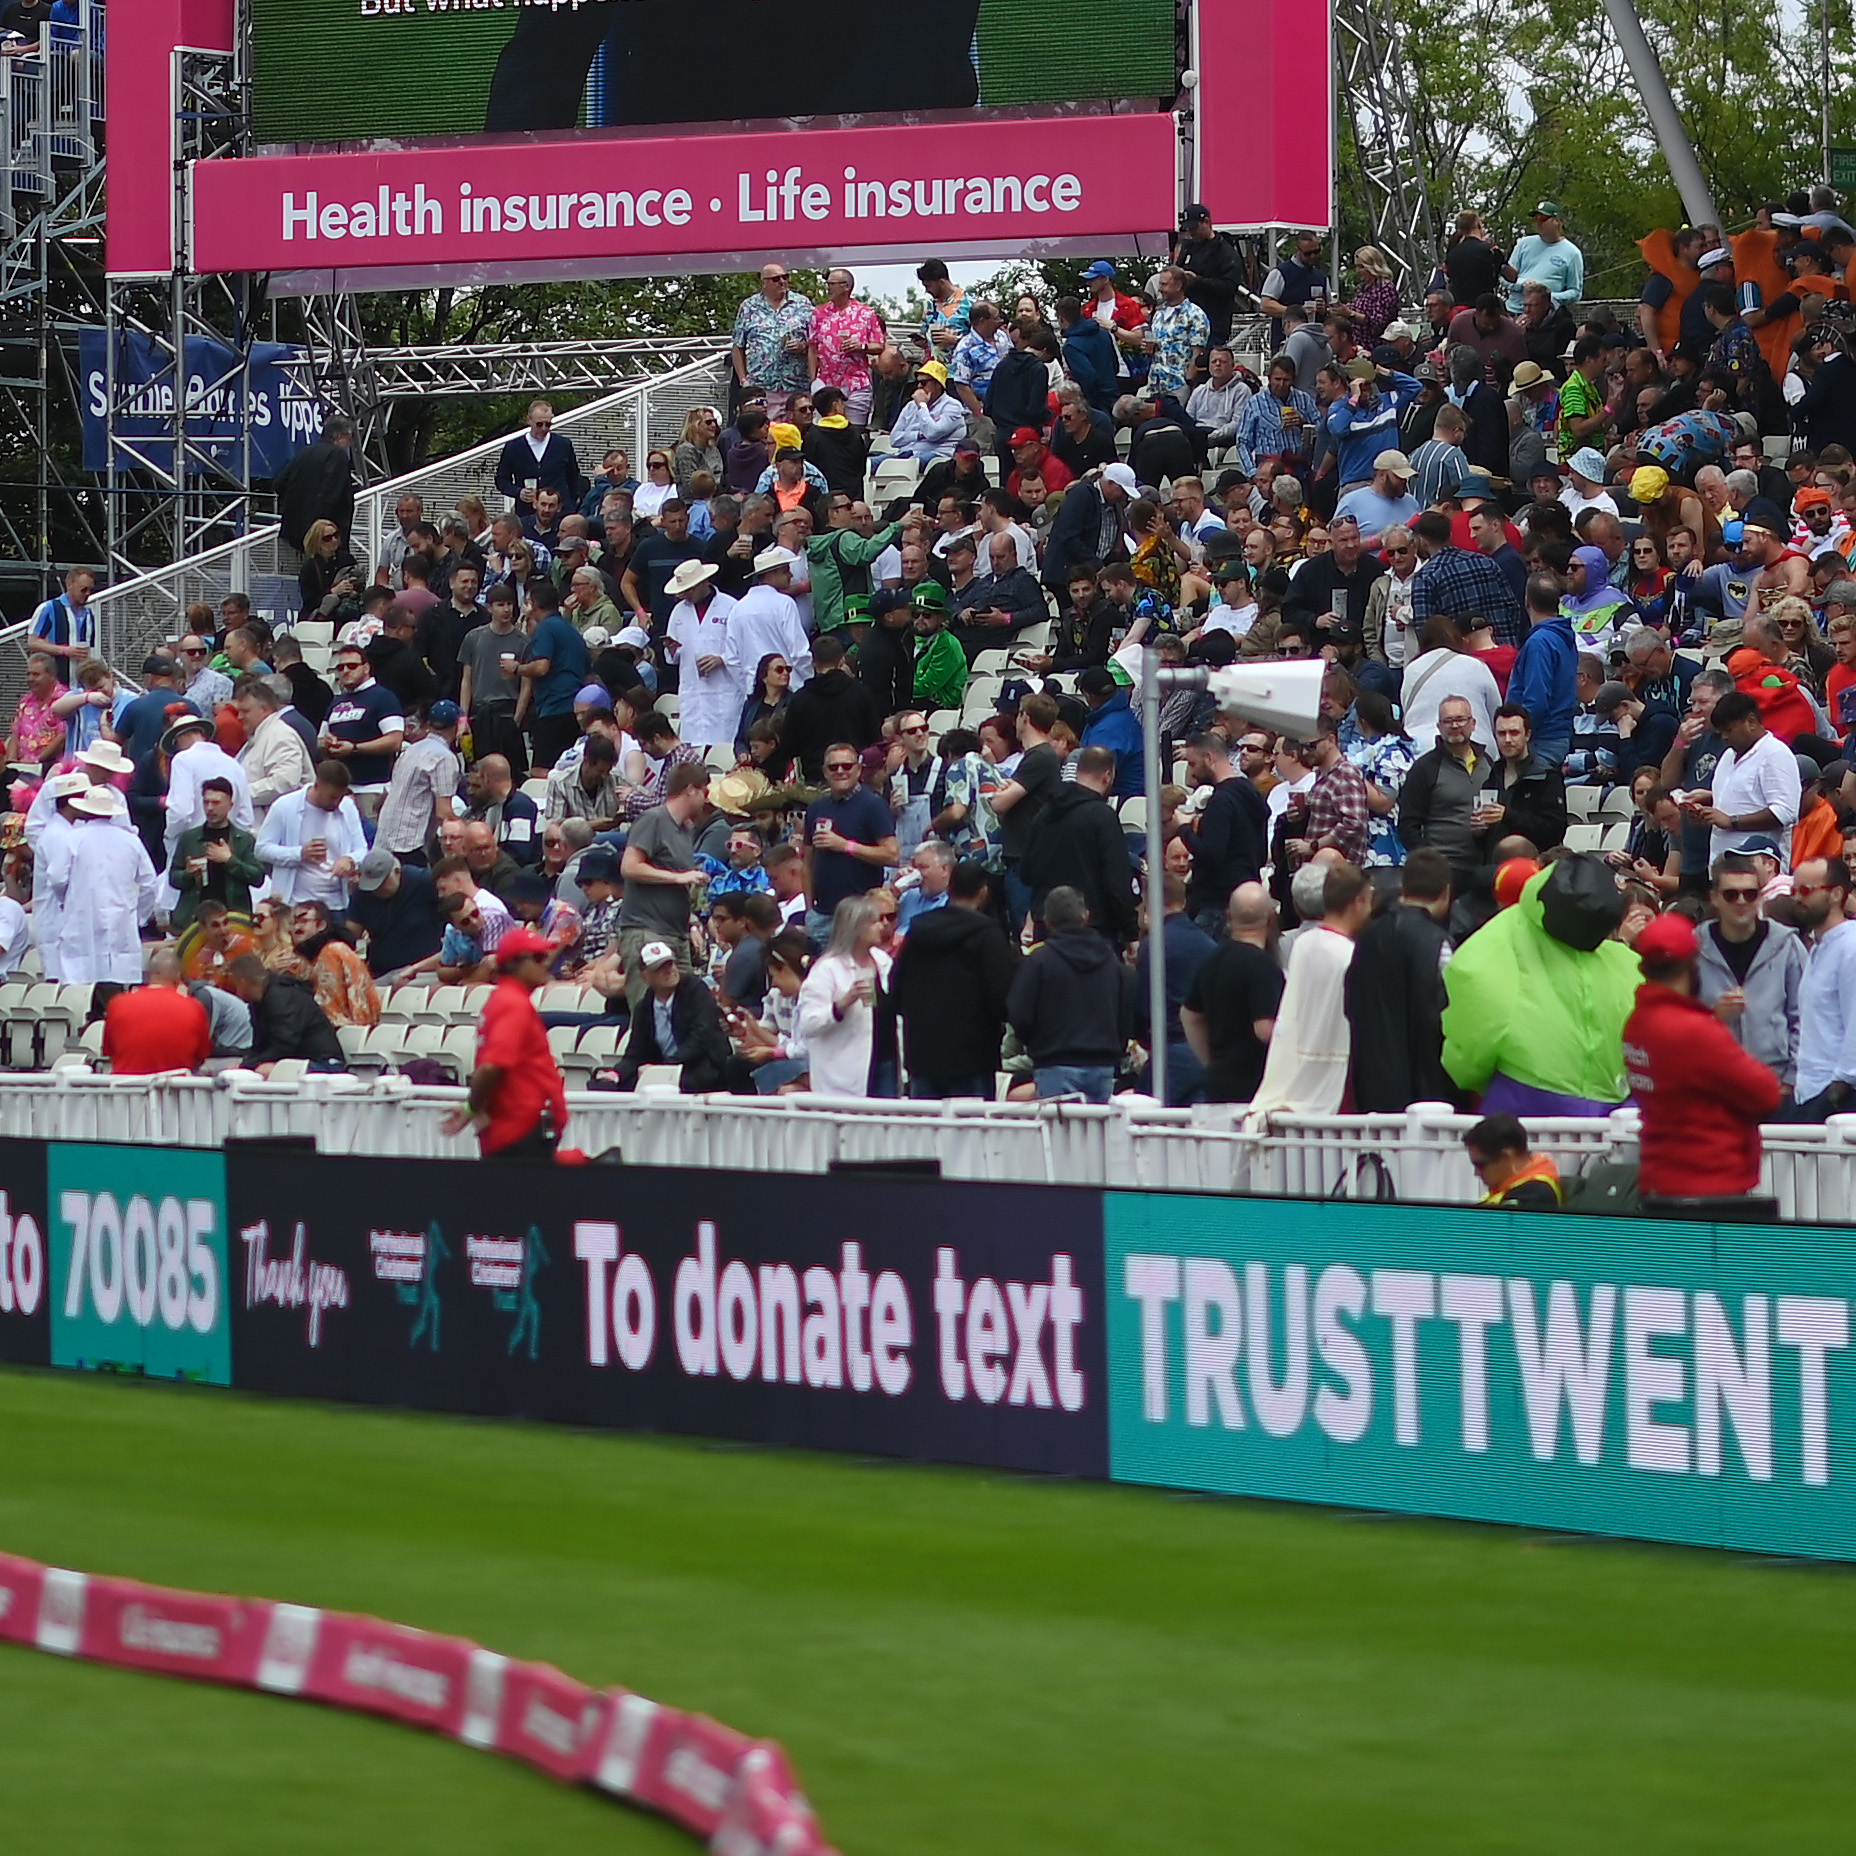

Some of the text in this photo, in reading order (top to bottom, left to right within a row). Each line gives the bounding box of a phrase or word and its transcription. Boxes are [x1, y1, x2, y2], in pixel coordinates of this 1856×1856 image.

[1831, 153, 1856, 168] FIRE
[1832, 171, 1856, 184] EXIT
[282, 166, 1082, 241] Health insurance Life insurance
[60, 1190, 219, 1333] 70085
[241, 1219, 306, 1310] Thank
[307, 1259, 350, 1348] you
[574, 1221, 655, 1370] To
[674, 1220, 912, 1396] donate
[934, 1247, 1084, 1412] text
